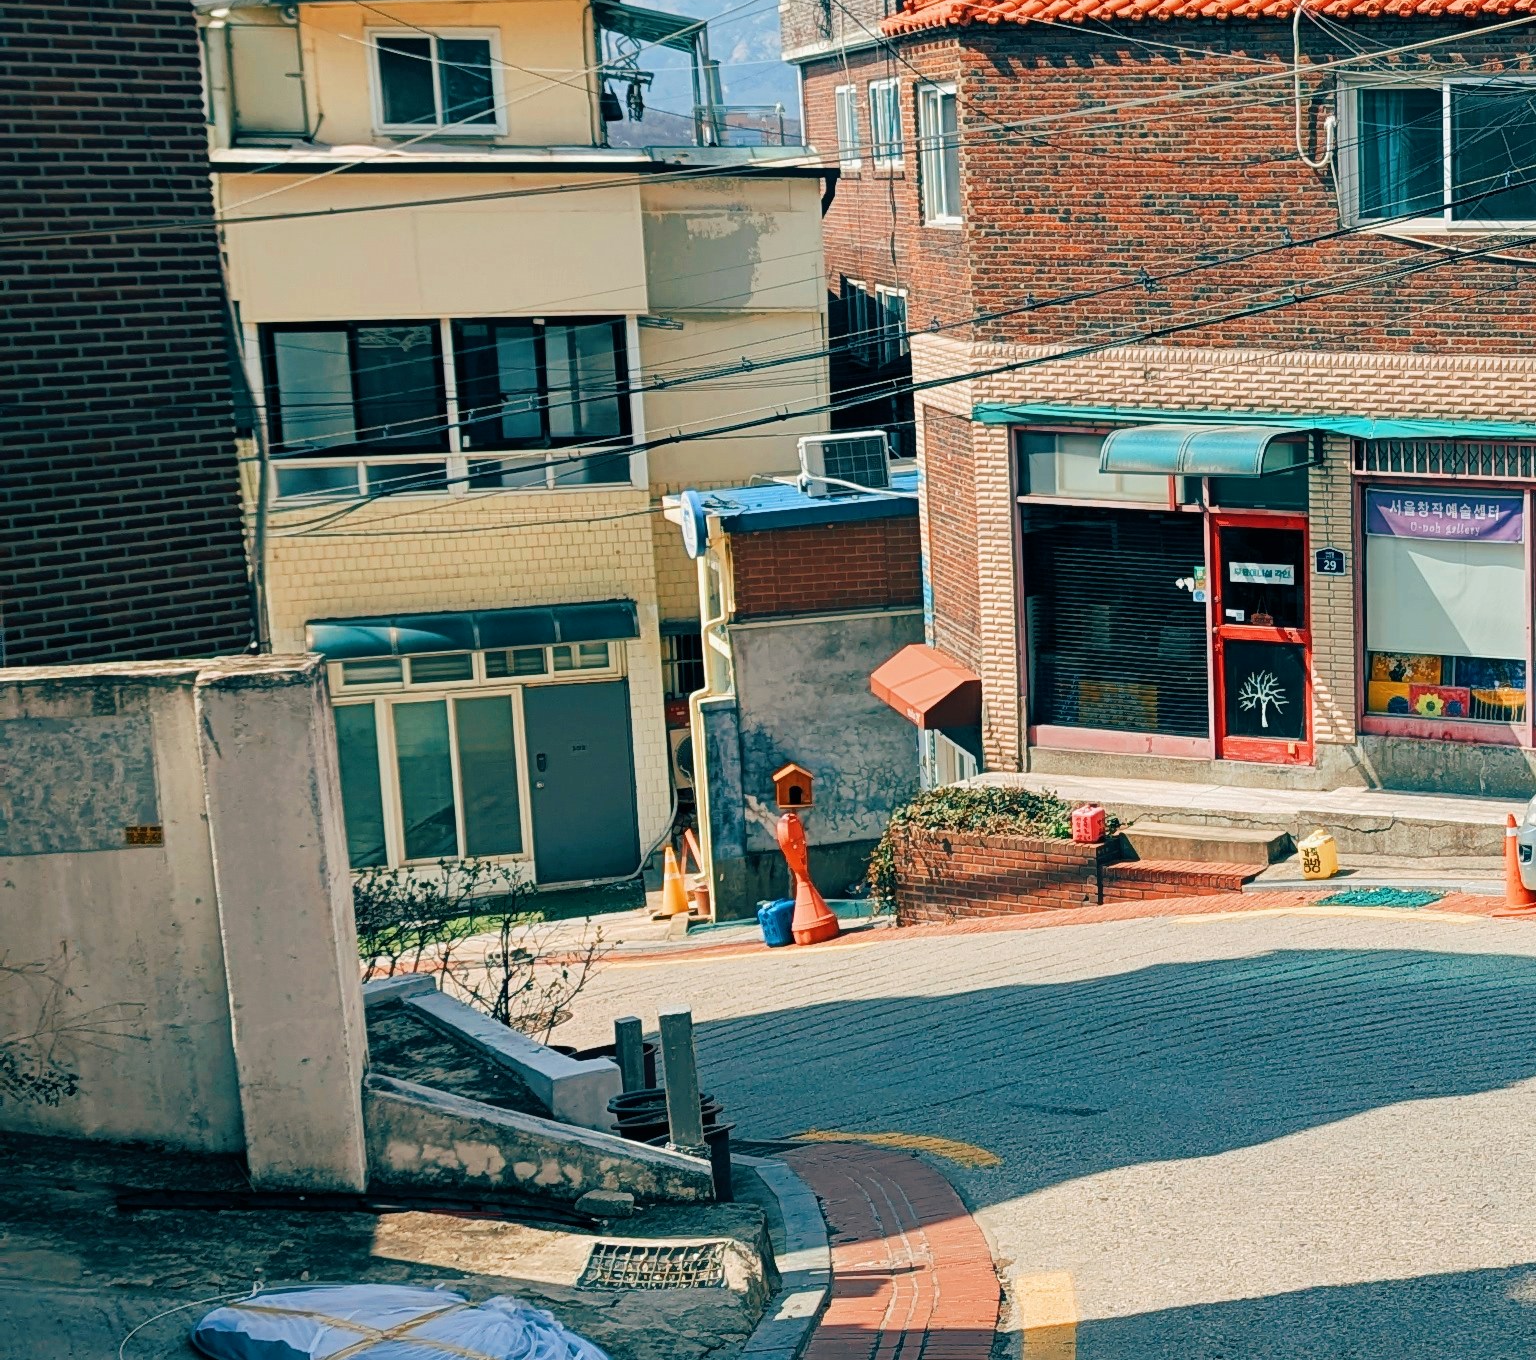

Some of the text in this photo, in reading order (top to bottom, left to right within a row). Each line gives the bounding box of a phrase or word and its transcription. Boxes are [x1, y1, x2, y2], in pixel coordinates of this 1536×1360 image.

[1389, 499, 1500, 521] 서울창작예술센터
[1445, 522, 1481, 536] gallery
[1323, 559, 1337, 571] 29
